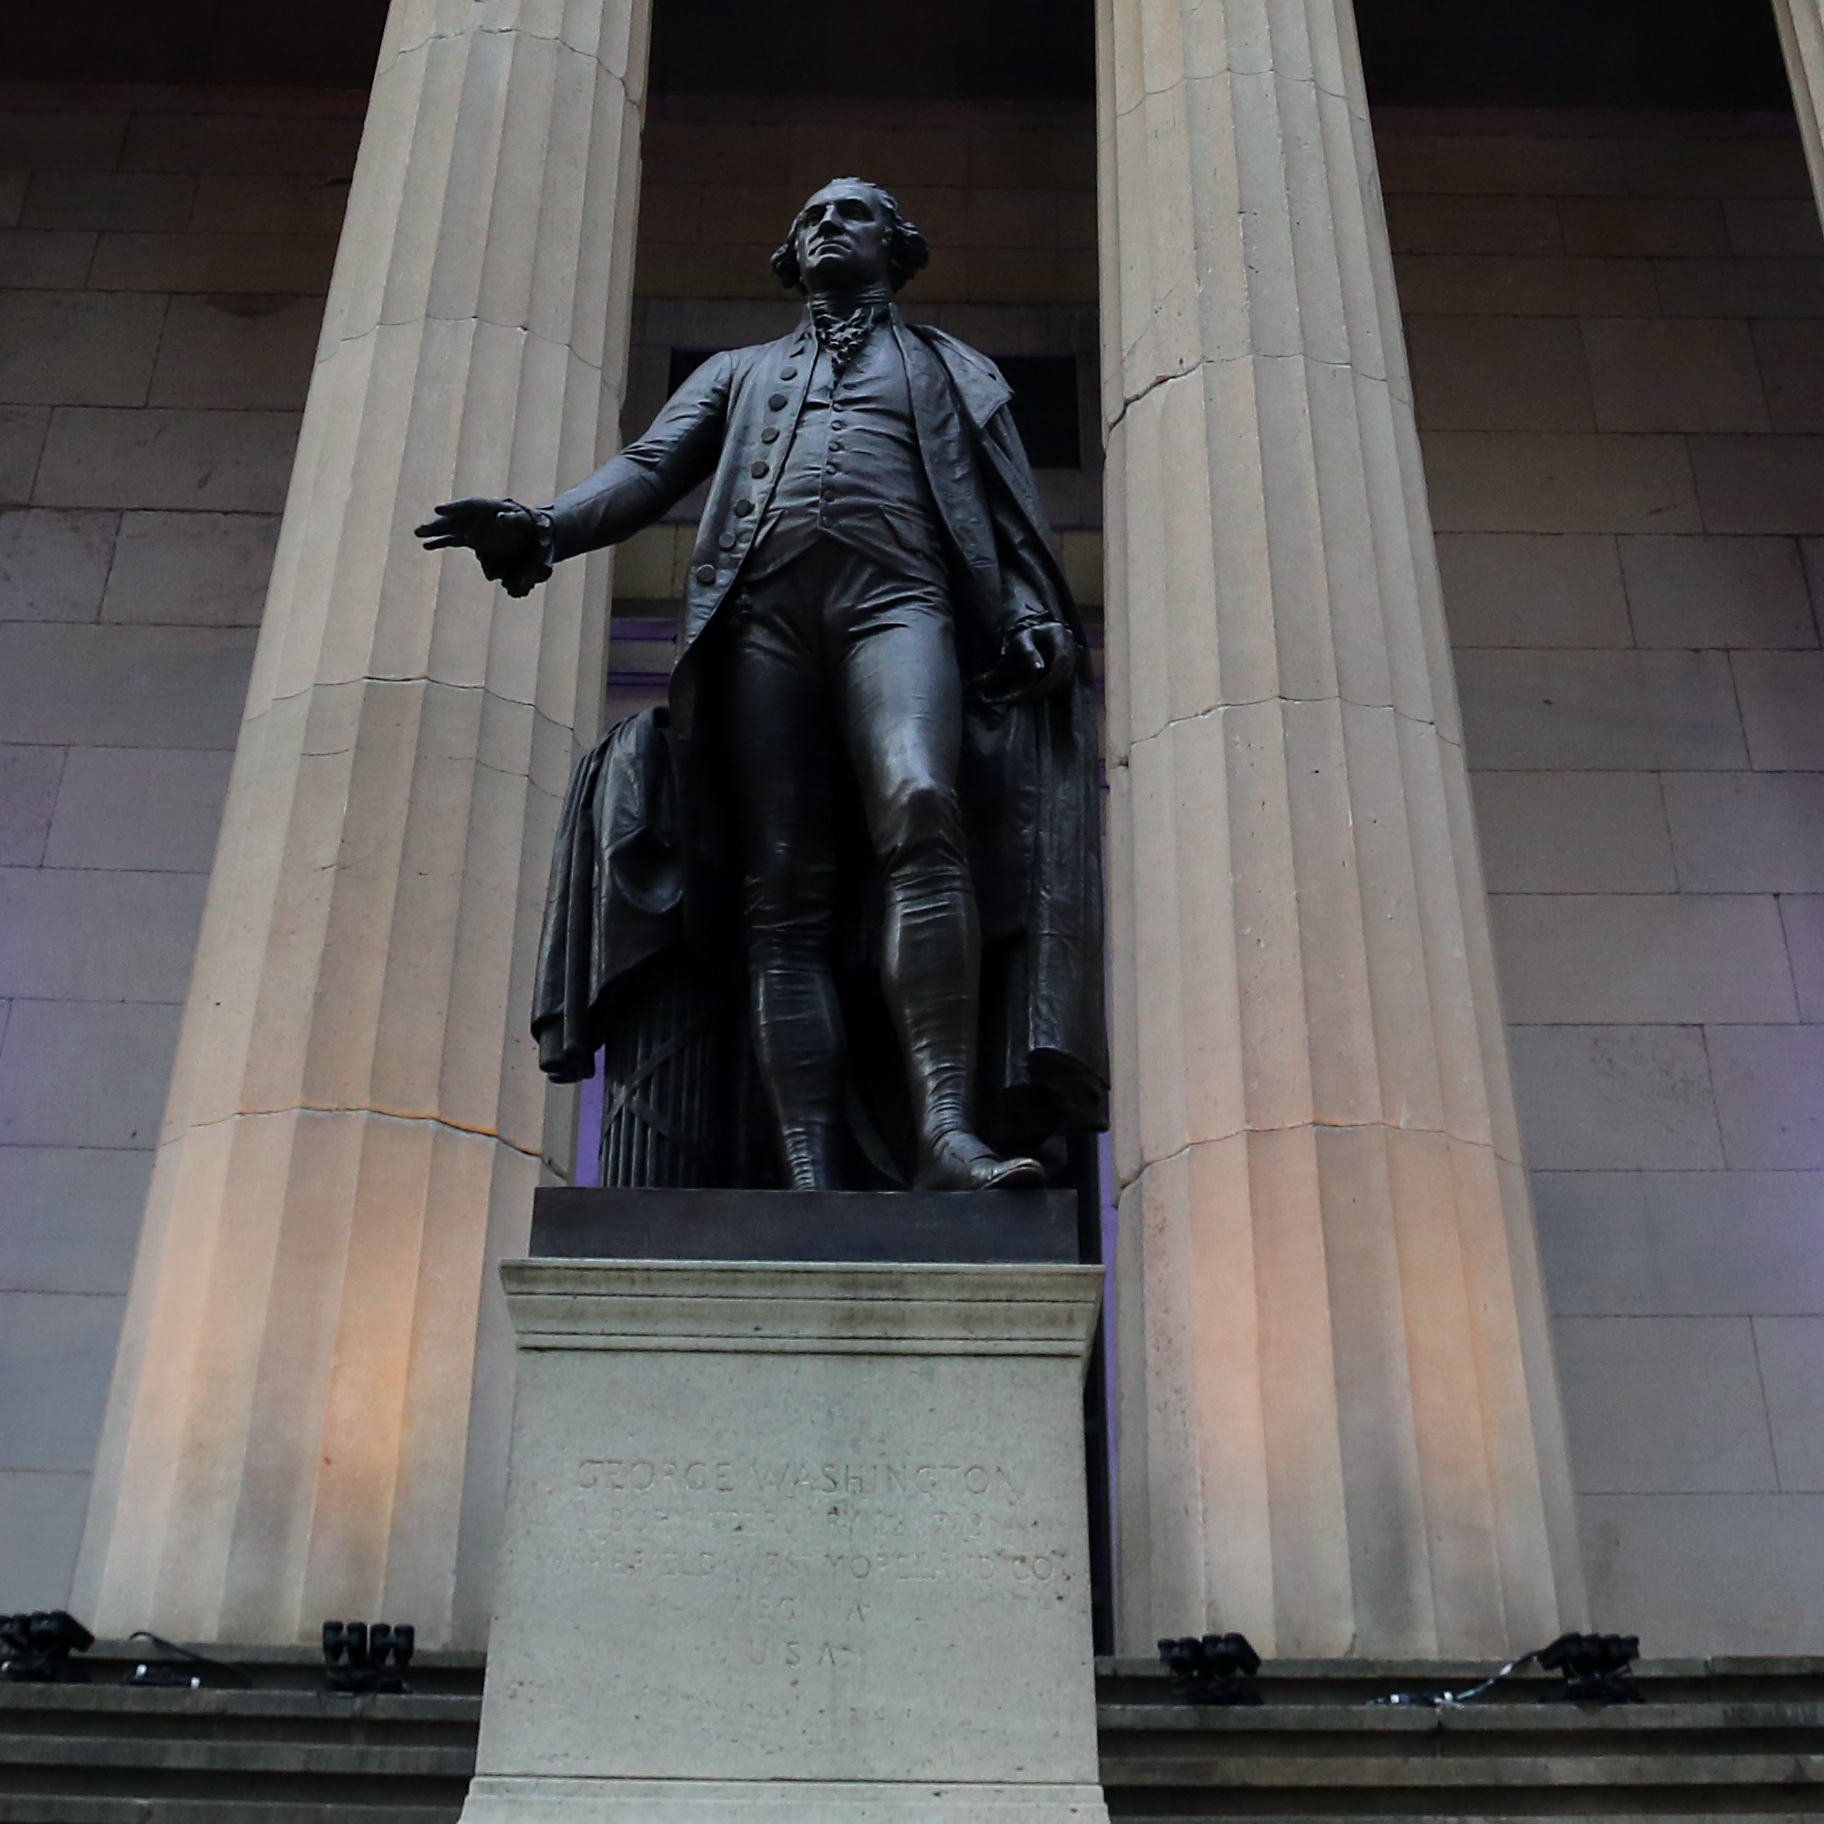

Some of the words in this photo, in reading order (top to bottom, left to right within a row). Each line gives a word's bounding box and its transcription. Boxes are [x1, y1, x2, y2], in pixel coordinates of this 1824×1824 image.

[577, 1459, 734, 1493] GEORGE
[750, 1461, 1023, 1497] WASHINGTON
[609, 1508, 697, 1533] BOR
[709, 1509, 859, 1536] FEBRURY
